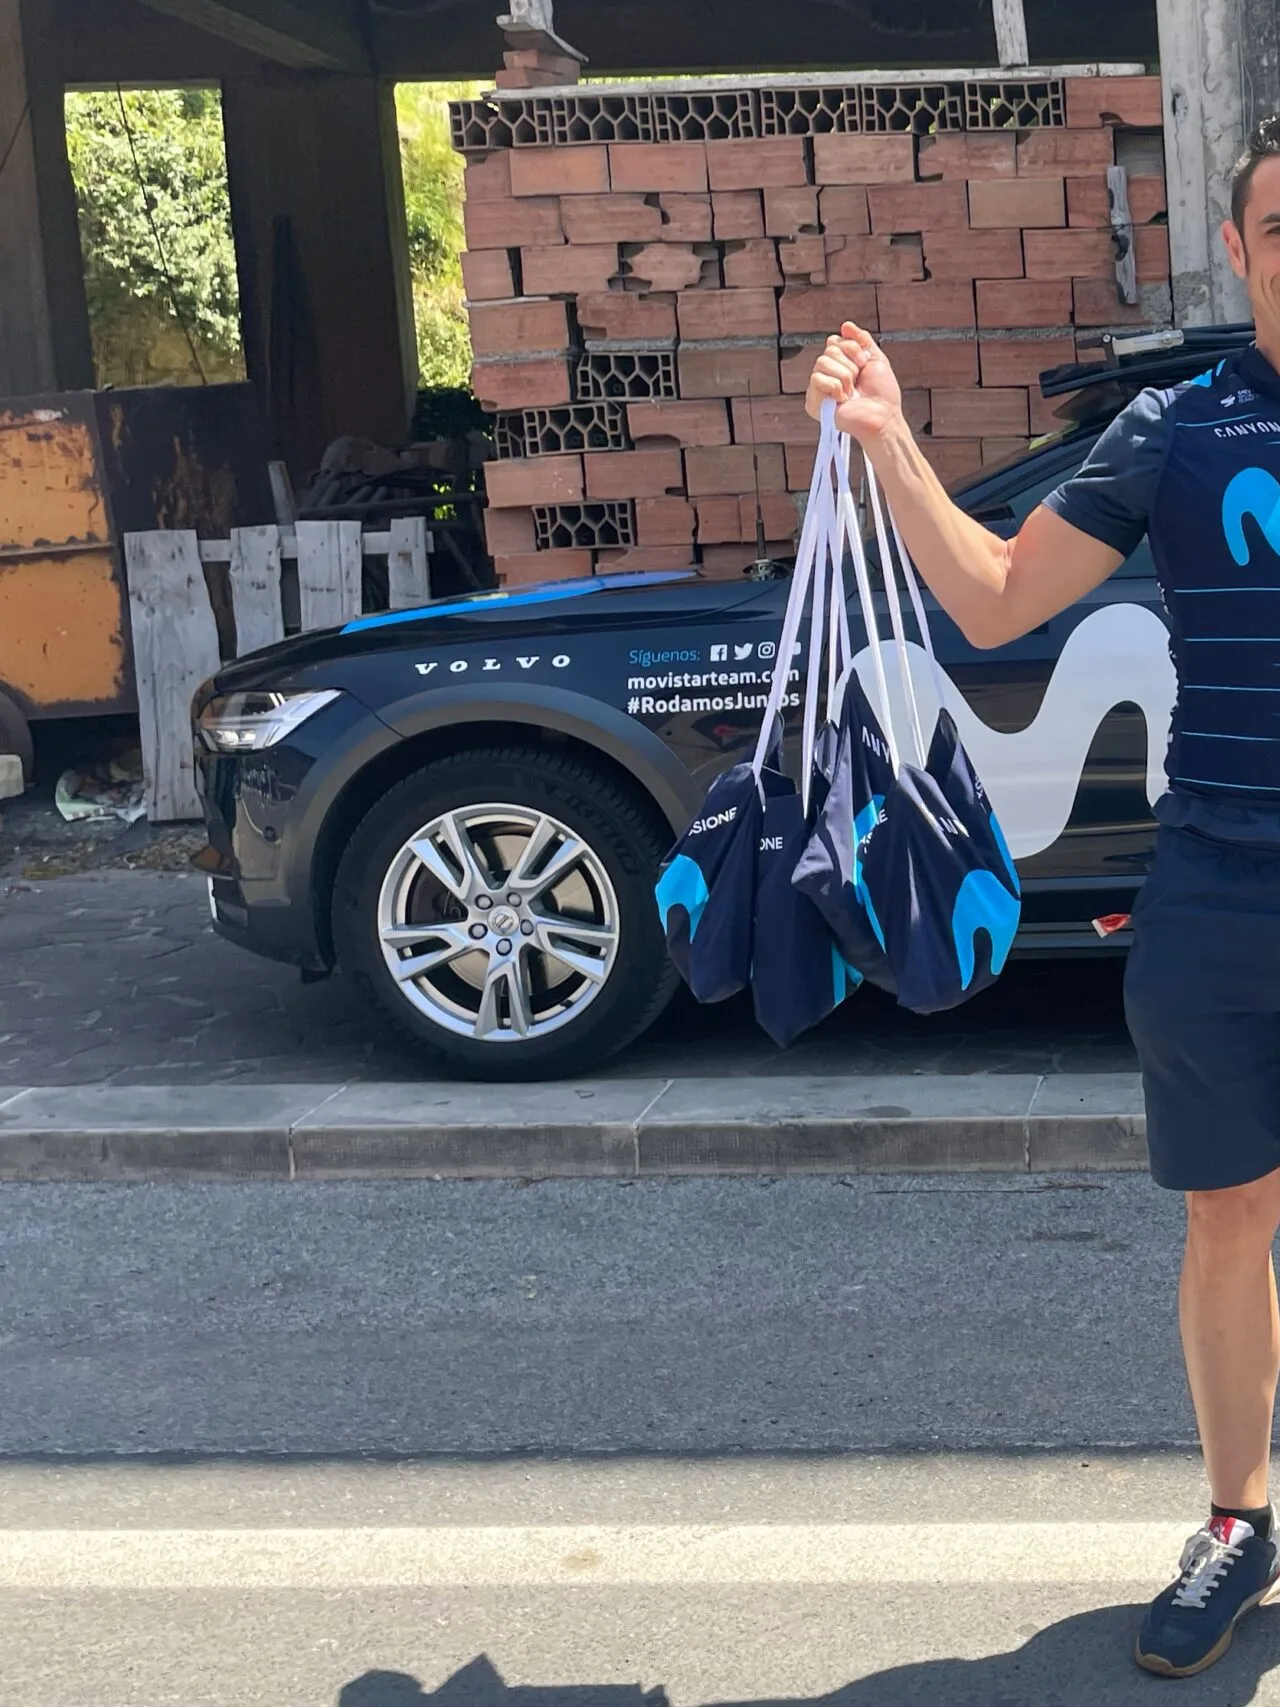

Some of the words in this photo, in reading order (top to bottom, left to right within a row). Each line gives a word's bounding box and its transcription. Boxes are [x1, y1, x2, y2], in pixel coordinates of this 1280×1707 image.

[414, 654, 571, 675] VOLVO
[629, 649, 701, 667] Síguenos:
[627, 669, 800, 690] movistarteam.cm
[627, 692, 800, 715] #RodamosJunos
